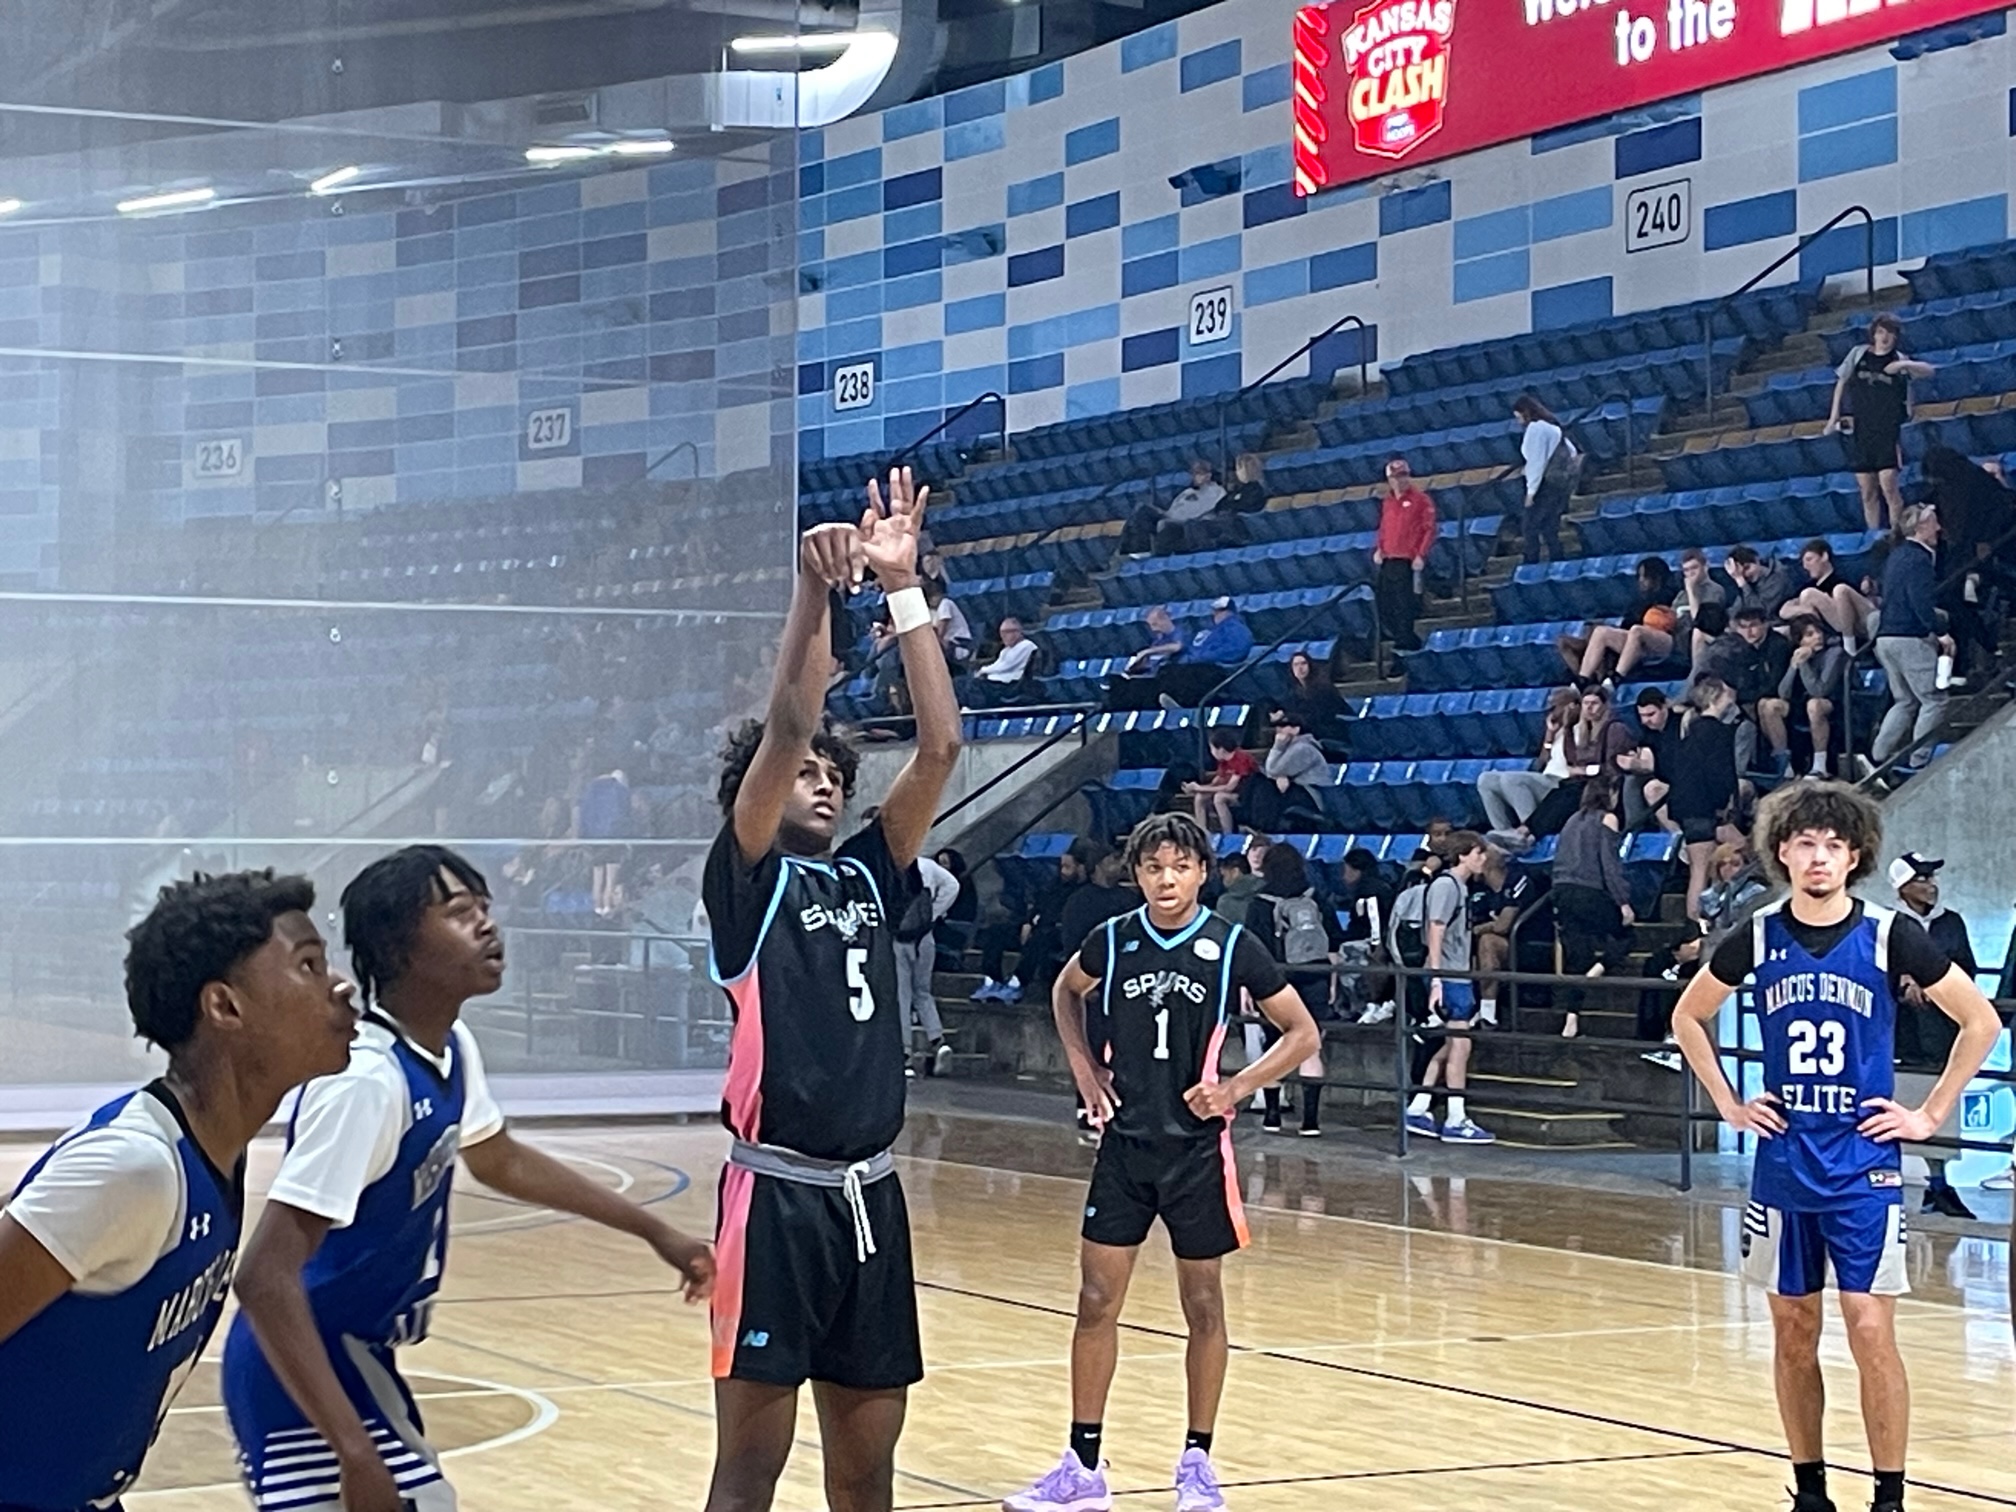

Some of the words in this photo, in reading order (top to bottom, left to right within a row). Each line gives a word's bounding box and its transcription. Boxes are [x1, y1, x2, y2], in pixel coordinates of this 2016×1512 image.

[1345, 0, 1452, 64] KANSAS
[1615, 9, 1657, 66] to
[1668, 0, 1738, 52] the
[1367, 35, 1428, 77] CITY
[1352, 54, 1446, 121] CLASH
[1636, 193, 1681, 238] 240
[1195, 297, 1226, 335] 239
[840, 371, 869, 402] 238
[532, 413, 566, 444] 237
[200, 444, 237, 471] 236
[847, 948, 876, 1022] 5
[1123, 970, 1206, 1007] SPURS
[1765, 972, 1815, 1016] MARCUS
[1153, 1008, 1170, 1060] 1
[1788, 1020, 1846, 1076] 23
[1782, 1084, 1857, 1113] ELITE
